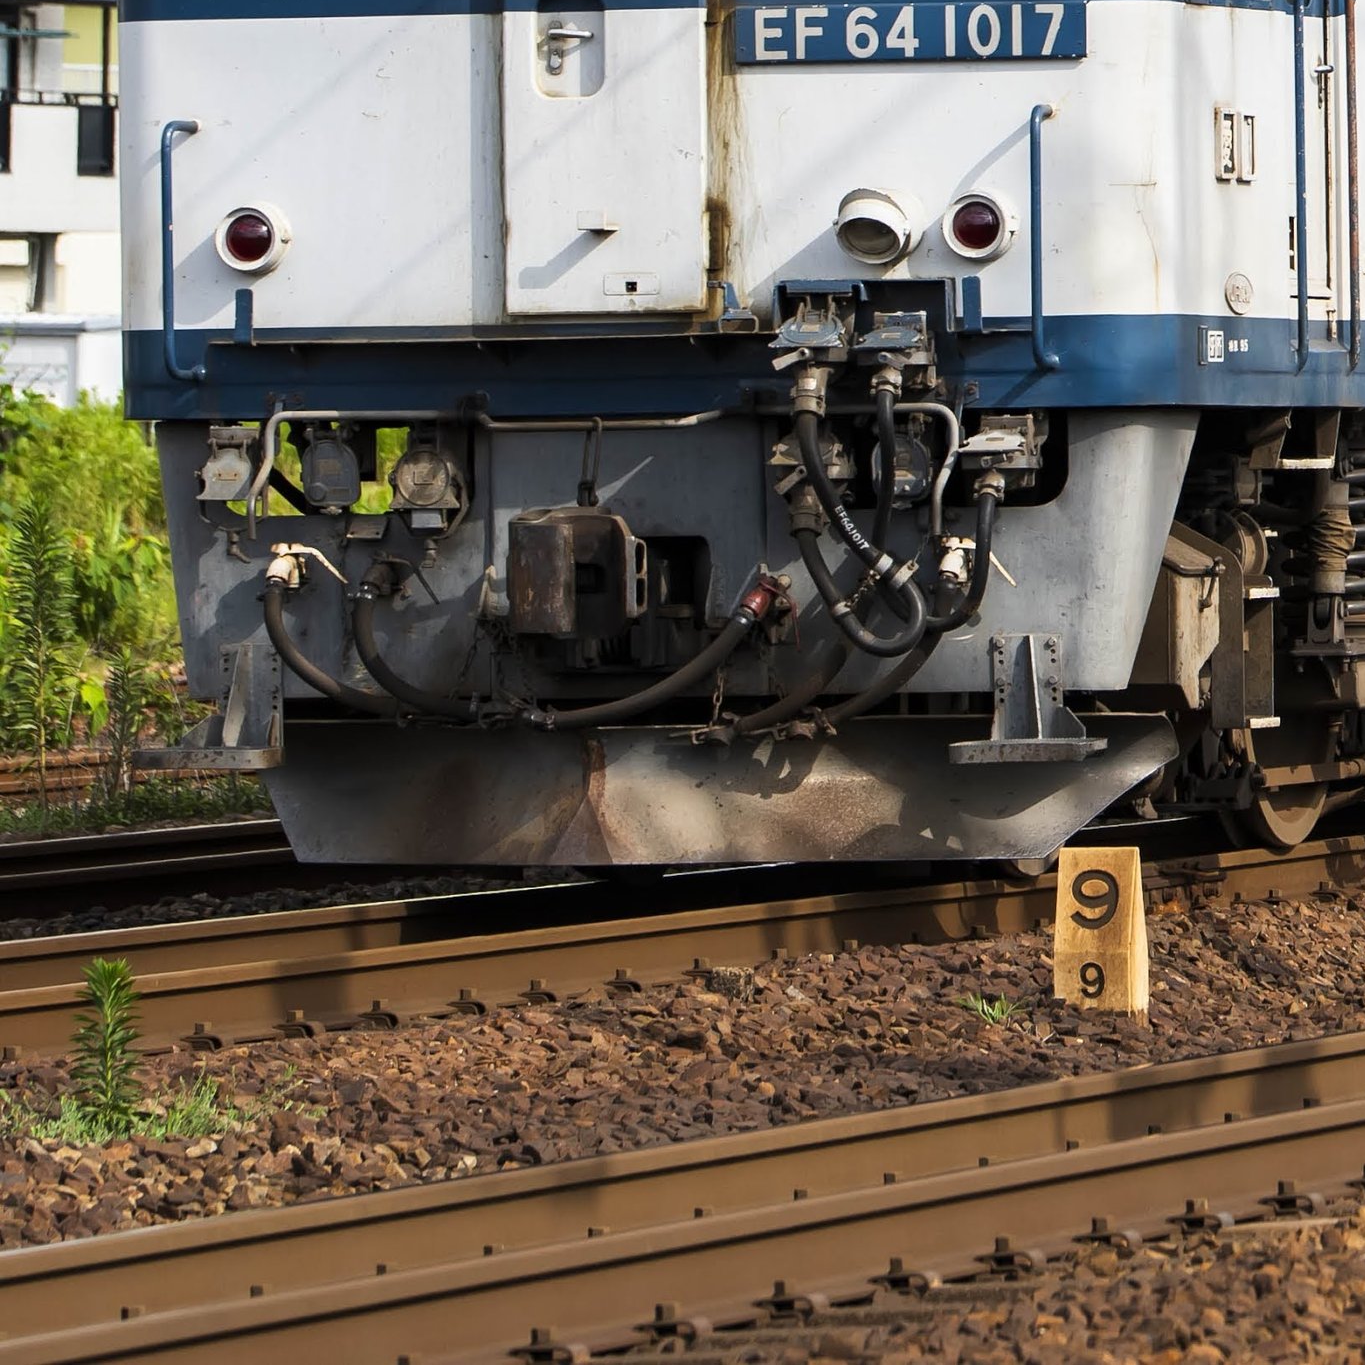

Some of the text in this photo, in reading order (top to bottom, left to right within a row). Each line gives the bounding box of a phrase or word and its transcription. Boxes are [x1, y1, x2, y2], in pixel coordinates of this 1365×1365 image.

[754, 3, 1065, 61] EF 64 1017
[1070, 868, 1119, 930] 9
[1080, 962, 1106, 999] 9
